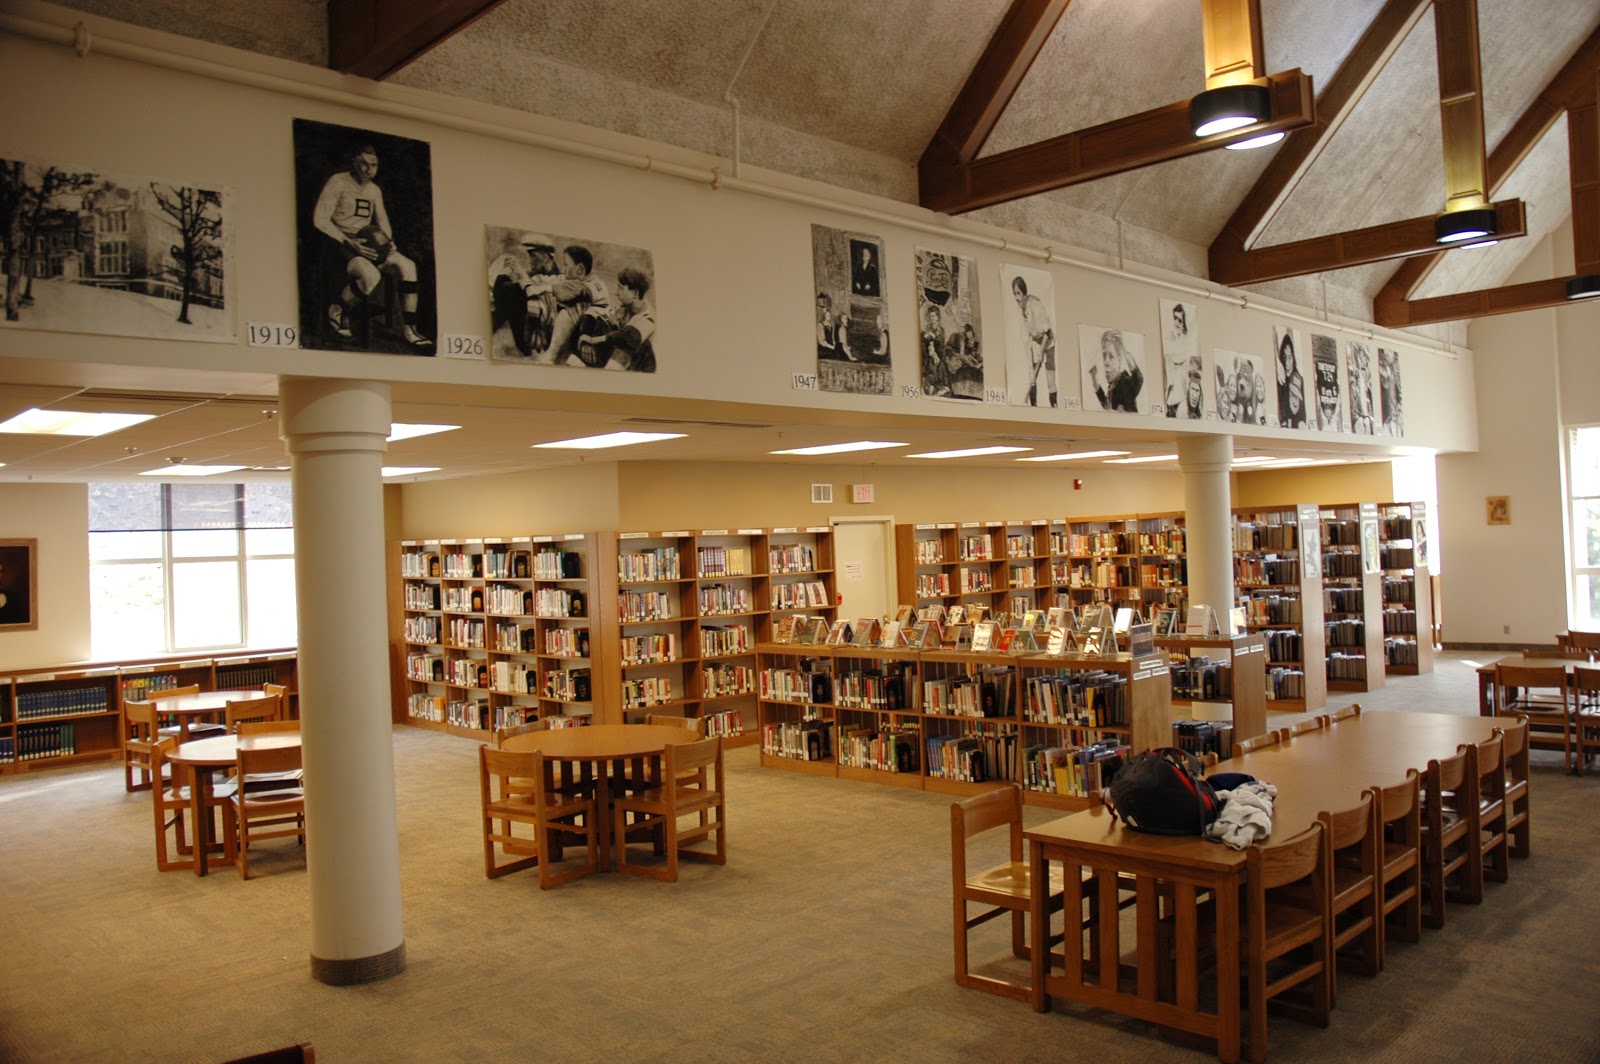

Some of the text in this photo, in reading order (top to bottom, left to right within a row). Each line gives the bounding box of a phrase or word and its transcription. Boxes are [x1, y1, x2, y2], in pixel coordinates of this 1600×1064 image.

[353, 198, 371, 218] B
[249, 325, 296, 345] 1919
[447, 337, 483, 355] 1926
[794, 374, 817, 390] 1947
[901, 384, 920, 399] 1956
[985, 390, 1006, 404] 1968
